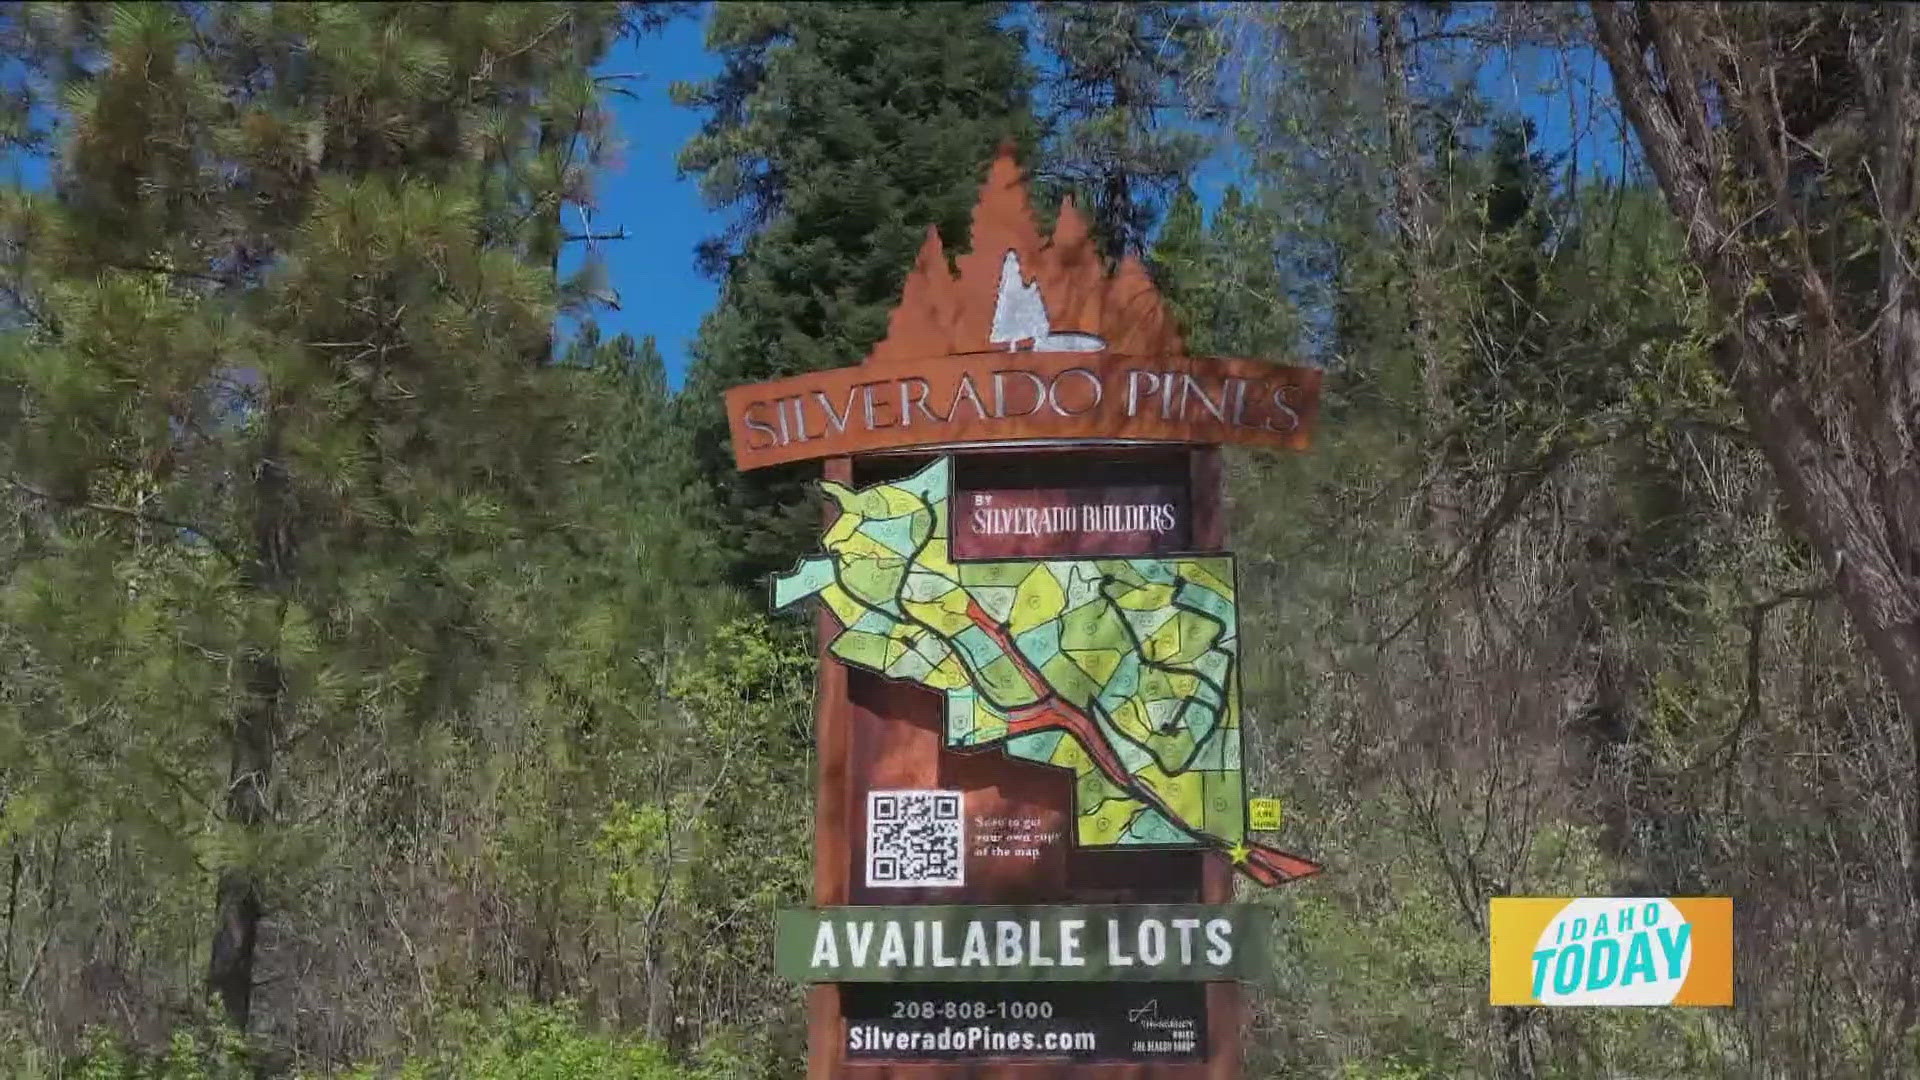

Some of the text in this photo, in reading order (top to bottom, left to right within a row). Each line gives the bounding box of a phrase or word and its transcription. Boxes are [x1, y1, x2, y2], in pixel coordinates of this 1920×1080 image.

[744, 366, 1301, 450] SILVERADO PINES
[974, 494, 993, 506] BY
[972, 502, 1177, 537] SILVERADO BUILDERS
[991, 846, 1010, 857] the
[1014, 848, 1040, 860] map
[810, 918, 1234, 968] AVAILABLE LOTS
[892, 1000, 1054, 1020] 208-808-1000
[848, 1026, 1096, 1052] SilveradoPines.com
